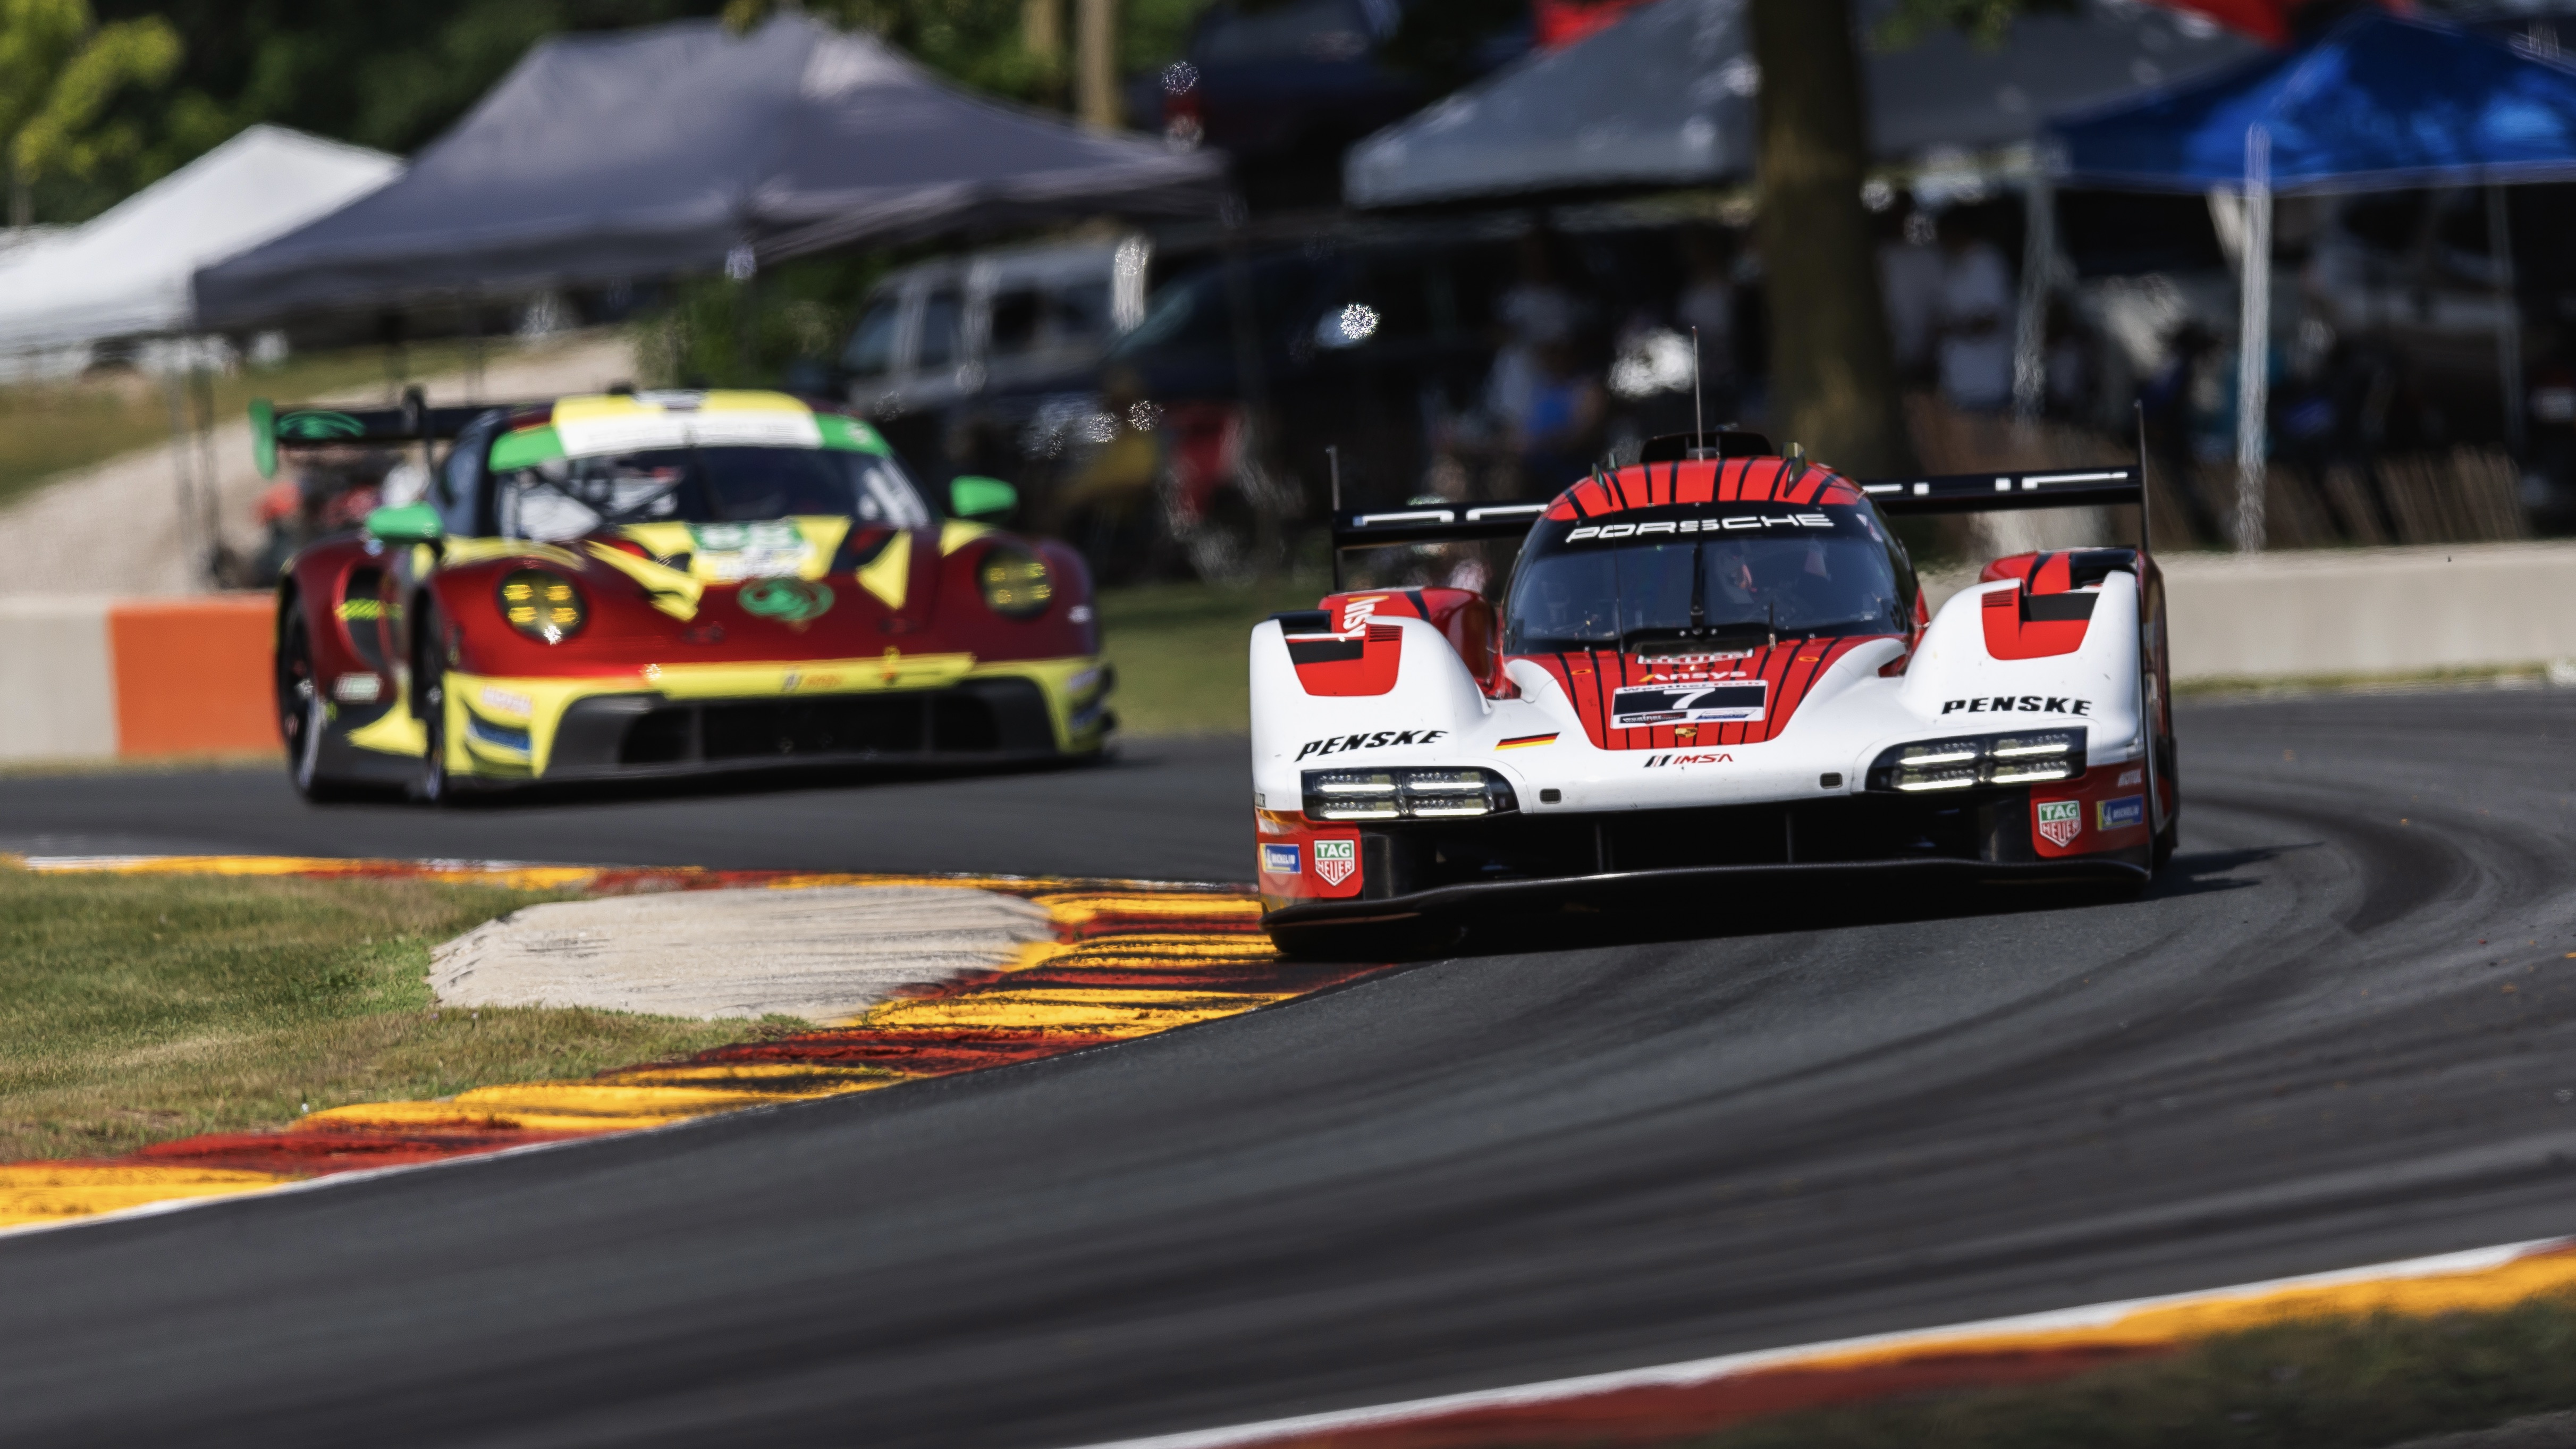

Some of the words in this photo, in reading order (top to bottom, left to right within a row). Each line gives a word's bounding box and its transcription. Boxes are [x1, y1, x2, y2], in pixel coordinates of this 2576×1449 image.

[1565, 513, 1836, 543] PORSCHE
[1638, 671, 1746, 682] Ansys
[1663, 688, 1716, 710] 7
[1941, 695, 2093, 716] PENSKE
[1294, 730, 1449, 762] PENSKE
[1673, 753, 1734, 764] IMSA
[2042, 803, 2077, 820] TAG
[2042, 821, 2080, 842] HEUER
[1317, 843, 1350, 857] TAG
[1316, 861, 1352, 882] HEUER
